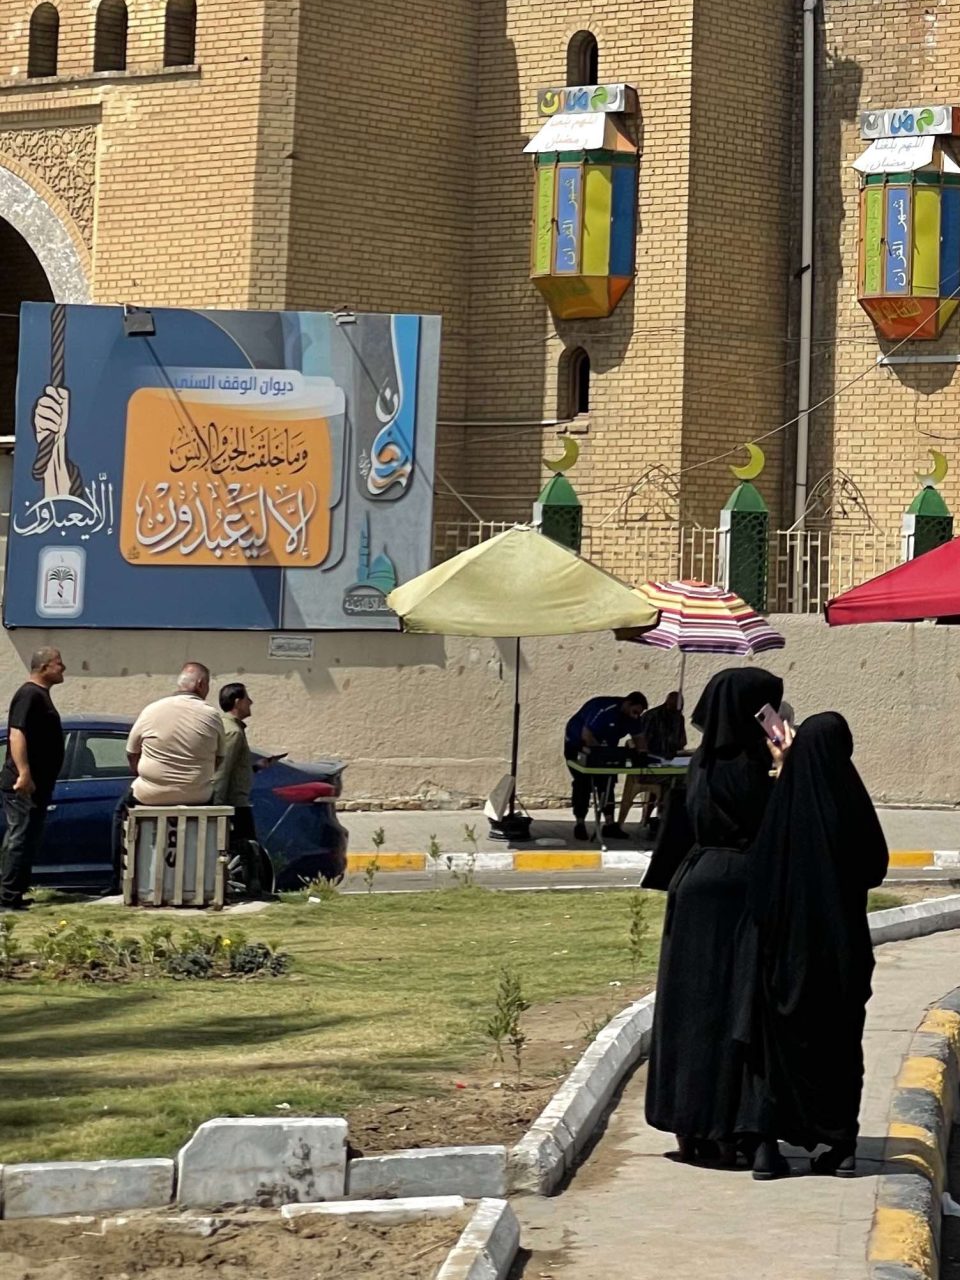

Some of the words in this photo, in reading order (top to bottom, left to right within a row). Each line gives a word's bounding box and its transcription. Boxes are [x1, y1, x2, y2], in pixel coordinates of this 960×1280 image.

[540, 86, 620, 114] رمضان
[863, 108, 947, 136] رمضان
[870, 157, 915, 170] رمضان
[892, 199, 907, 232] شهر
[175, 375, 215, 393] السني
[219, 376, 257, 395] الوقف
[260, 376, 294, 396] ديوان
